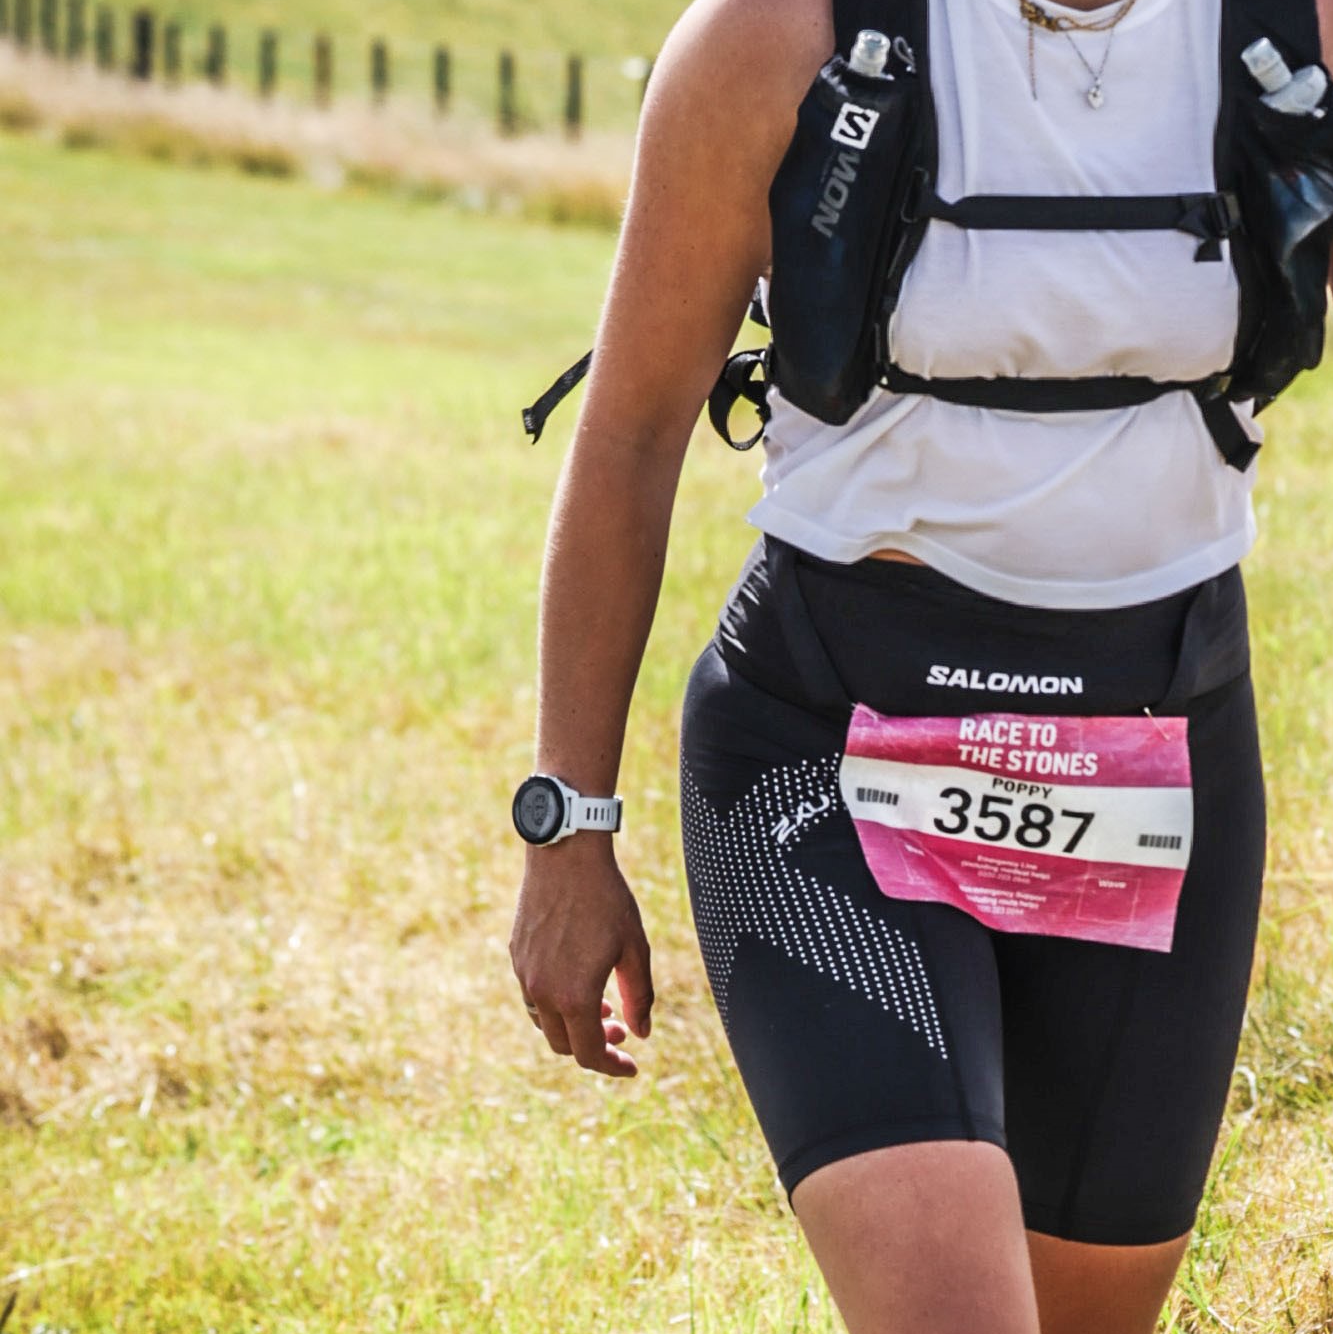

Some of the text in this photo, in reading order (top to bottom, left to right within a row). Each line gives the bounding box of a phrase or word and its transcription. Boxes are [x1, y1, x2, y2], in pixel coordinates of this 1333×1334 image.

[926, 665, 1083, 695] SALOMON
[958, 718, 1057, 748] RACE TO
[957, 744, 1099, 777] THE STONES
[992, 777, 1053, 799] POPPY
[933, 787, 1095, 854] 3587
